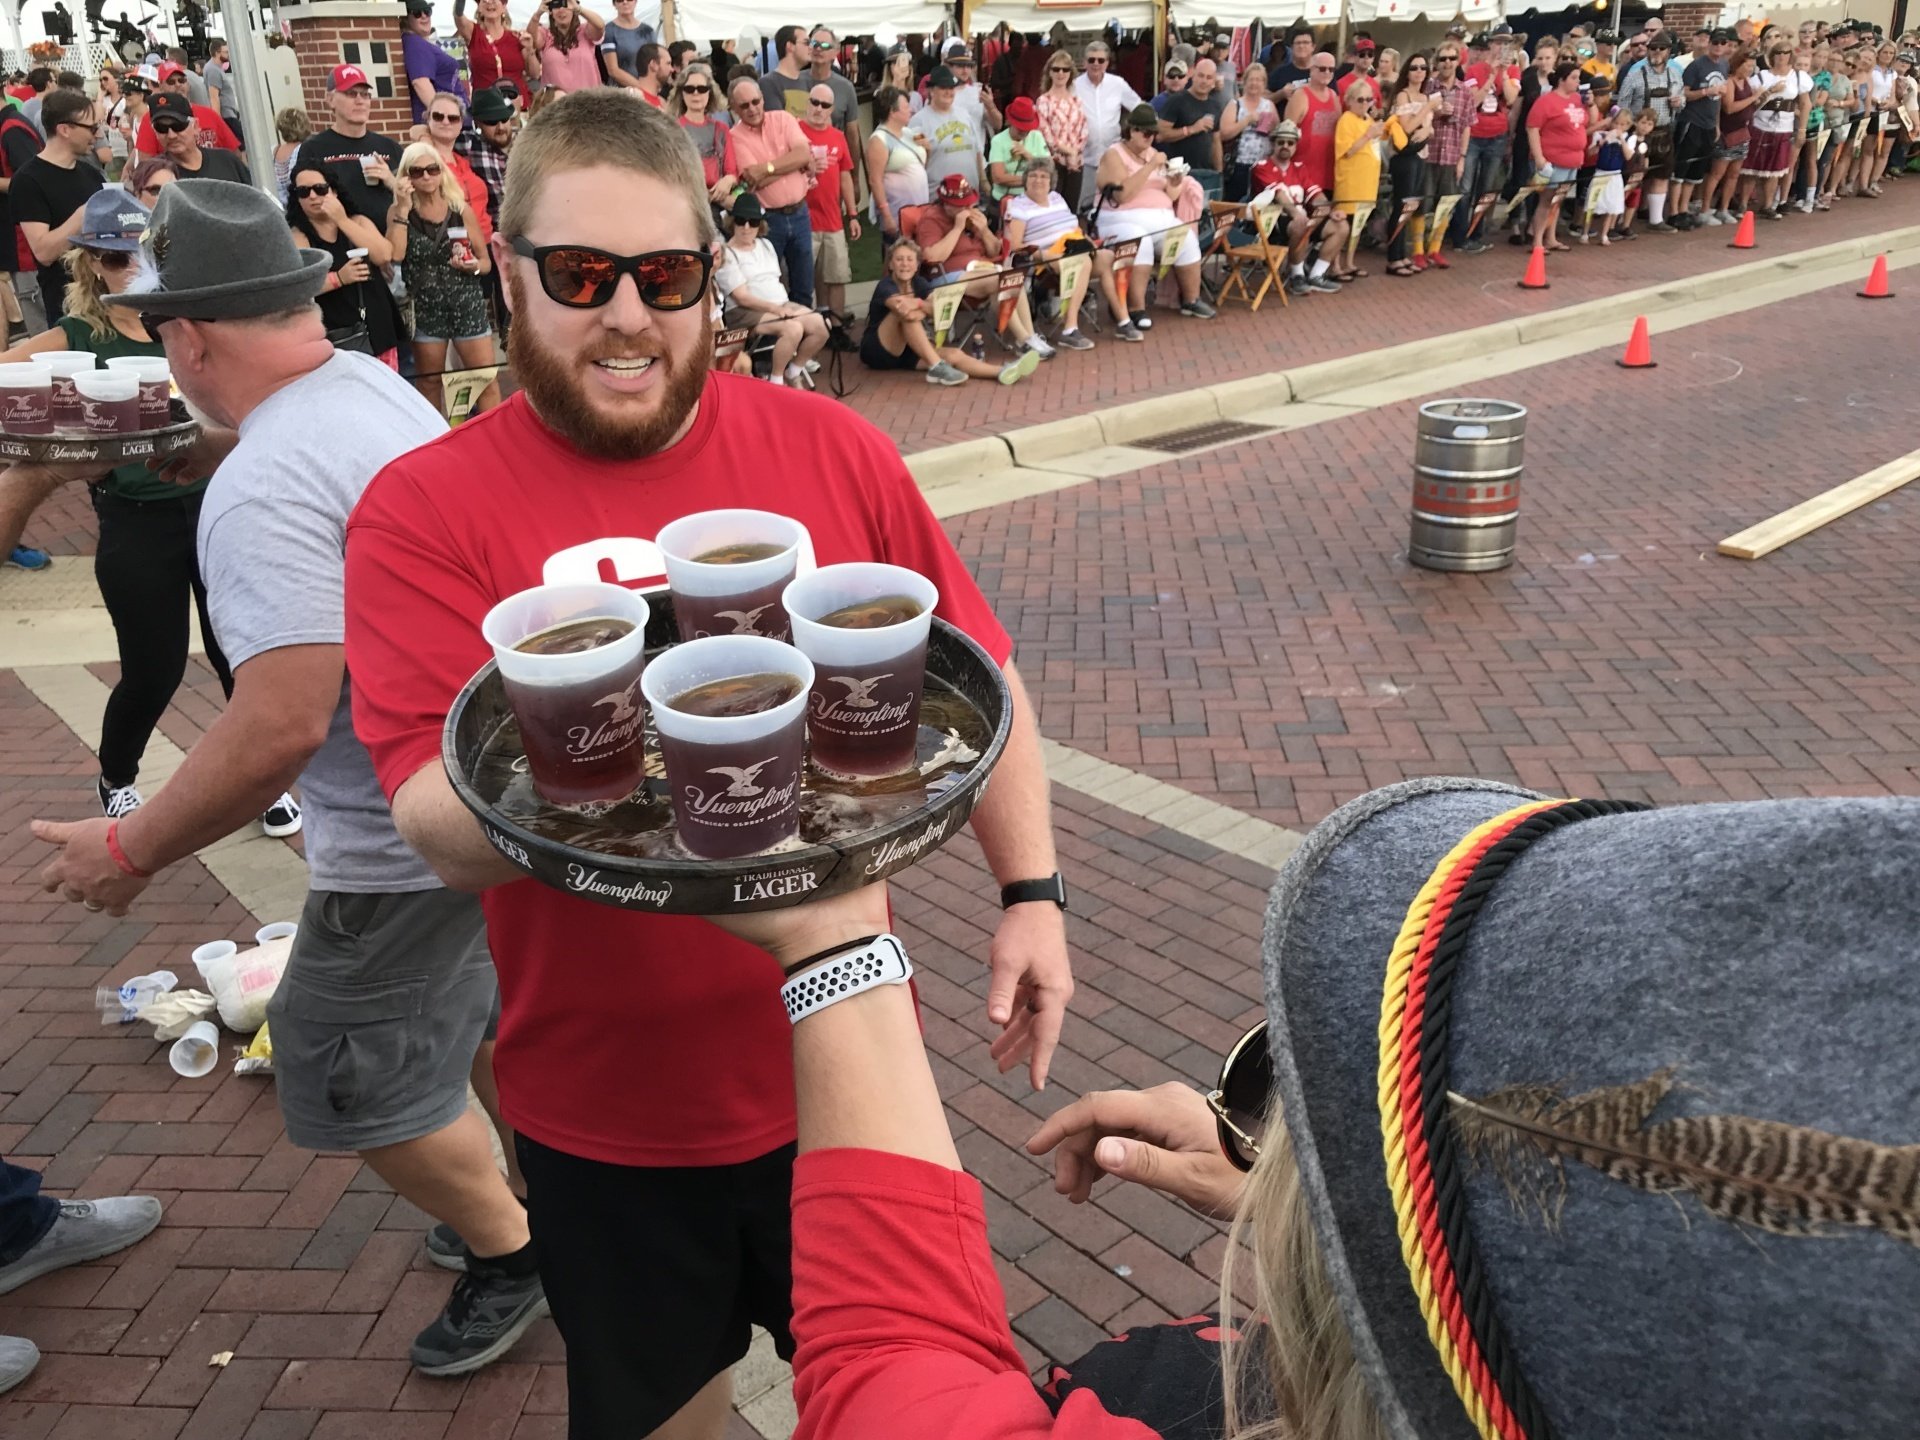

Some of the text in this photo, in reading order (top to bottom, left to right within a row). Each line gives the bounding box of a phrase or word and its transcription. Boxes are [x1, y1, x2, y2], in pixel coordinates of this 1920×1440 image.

[1, 444, 31, 457] LAGER
[49, 444, 99, 460] Yuengling
[122, 443, 154, 456] LAGER
[809, 691, 914, 729] Yuengling
[684, 771, 798, 818] Yuengling
[485, 823, 534, 869] LAGER
[865, 810, 951, 875] Yuengling
[565, 862, 673, 907] Yuengling
[733, 871, 819, 902] LAGER
[742, 866, 809, 882] TRADITIONAL
